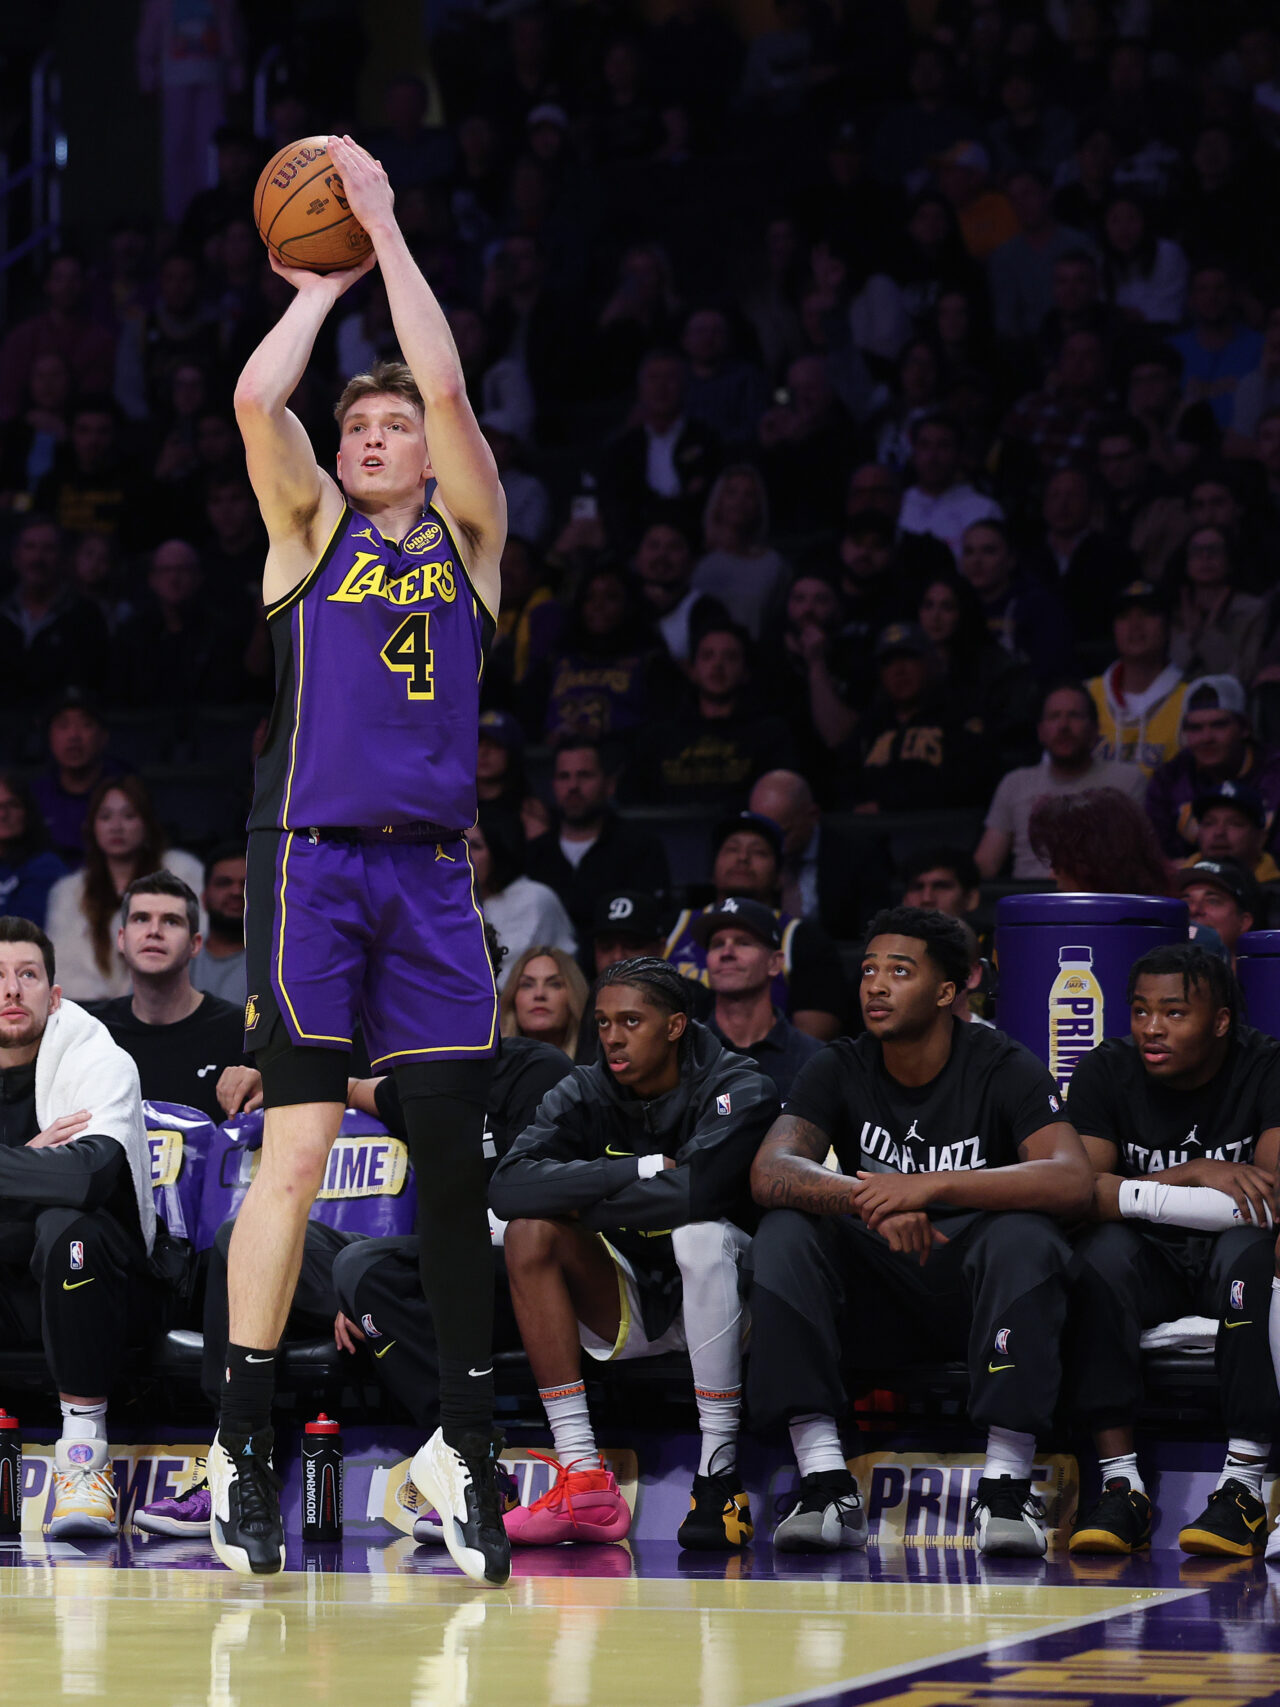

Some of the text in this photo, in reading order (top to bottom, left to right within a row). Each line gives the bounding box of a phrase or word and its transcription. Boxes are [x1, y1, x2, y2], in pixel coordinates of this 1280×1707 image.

[271, 144, 329, 189] Wils
[406, 526, 439, 550] bibigo
[327, 551, 457, 605] LAKERS
[380, 612, 435, 701] 4
[608, 896, 634, 921] D
[320, 1145, 389, 1190] IME
[860, 1121, 987, 1174] UTAH JAZZ
[20, 1459, 185, 1526] PME
[306, 1460, 316, 1524] BODYARMOR
[867, 1467, 1048, 1537] PRI
